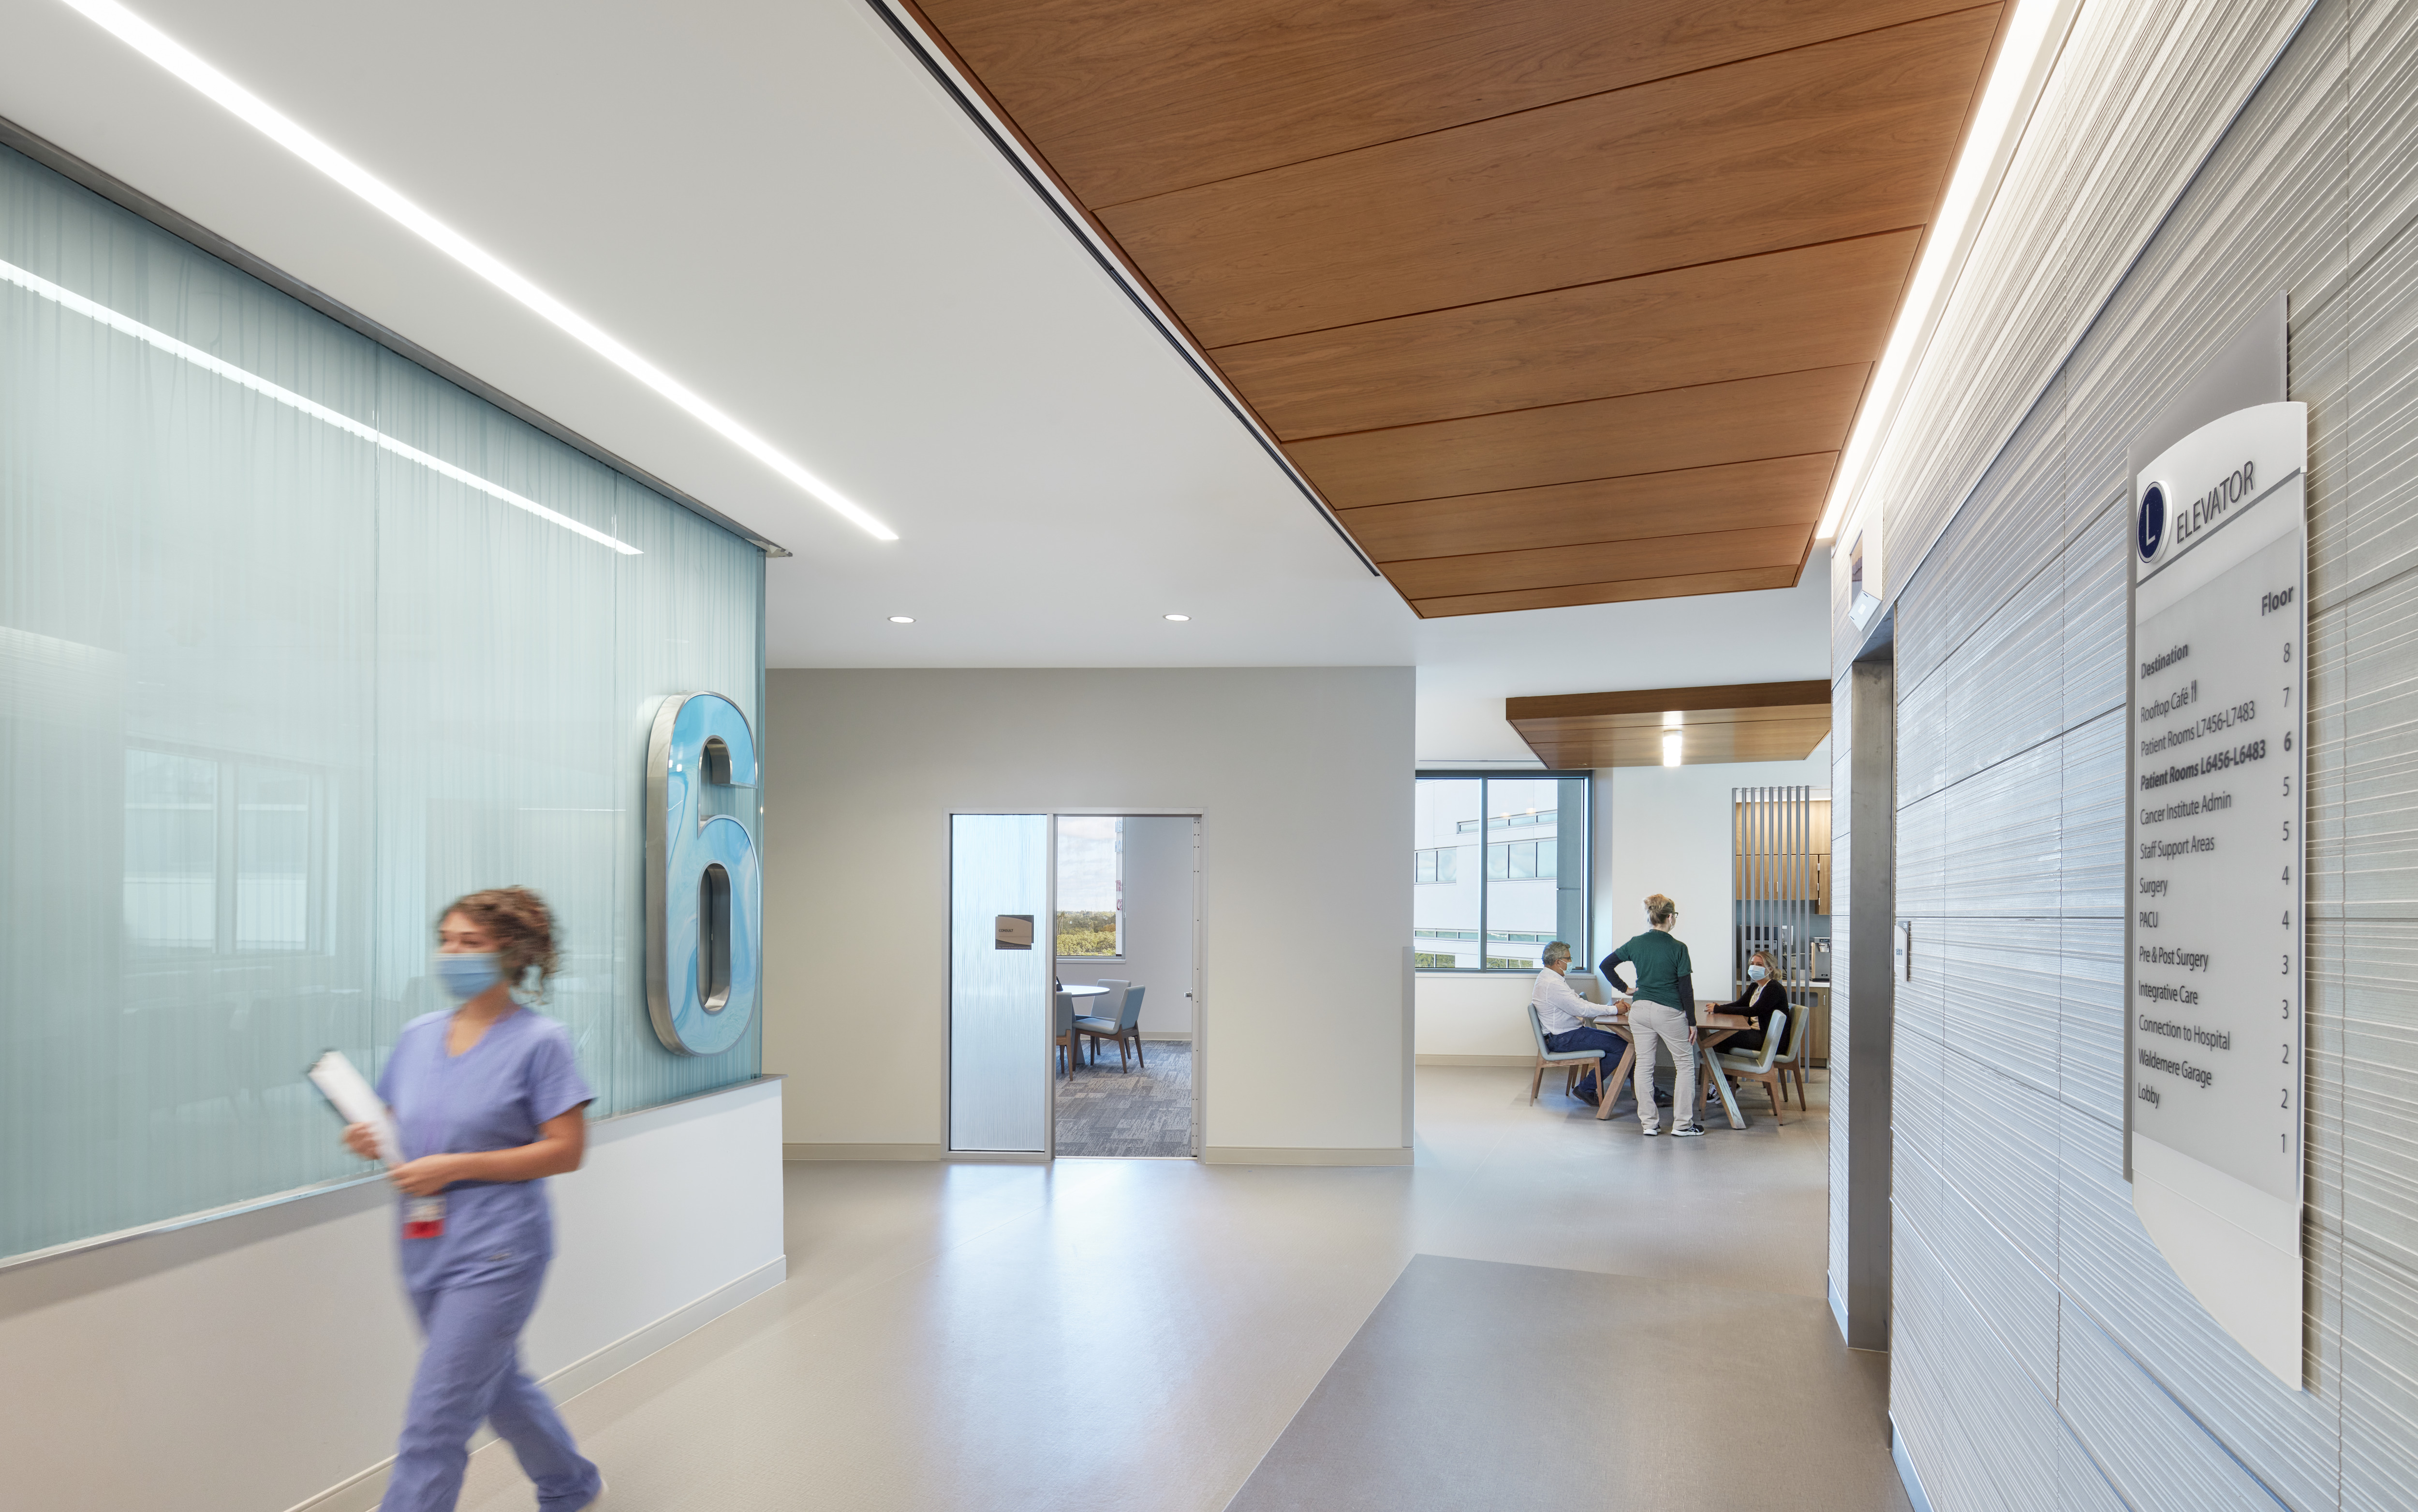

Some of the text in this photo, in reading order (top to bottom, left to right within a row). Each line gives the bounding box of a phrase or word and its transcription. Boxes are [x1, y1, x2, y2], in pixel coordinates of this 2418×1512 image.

[2177, 460, 2255, 544] ELEVATOR
[2146, 503, 2156, 546] L
[2261, 586, 2294, 617] Floor
[2141, 644, 2189, 679] Destination
[2283, 642, 2291, 663] 8
[2140, 687, 2189, 723] Rooftop Café
[2283, 687, 2290, 708] 7
[2141, 700, 2256, 757] Patient Rooms L7456-L7483
[2284, 731, 2292, 751] 6
[2140, 739, 2266, 791] Patient Rooms L6456-L6483
[2283, 776, 2290, 797] 5
[2140, 791, 2232, 825] Cancer Institute Admin
[2282, 821, 2289, 841] 5
[2140, 835, 2215, 861] Staff Support Areas
[646, 690, 758, 1057] 6
[2282, 866, 2290, 885] 4
[2139, 877, 2168, 897] Surgery
[2139, 911, 2158, 928] PACU
[2282, 910, 2290, 930] 4
[2139, 946, 2209, 972] Pre & Post Surgery
[2282, 954, 2288, 975] 3
[2138, 980, 2198, 1005] Integrative Care
[2282, 999, 2289, 1019] 3
[2139, 1014, 2230, 1051] Connection to Hospital
[2282, 1044, 2289, 1065] 2
[2138, 1048, 2212, 1089] Waldemere Garage
[2138, 1082, 2160, 1109] Lobby
[2281, 1088, 2288, 1109] 2
[2281, 1133, 2286, 1153] 1
